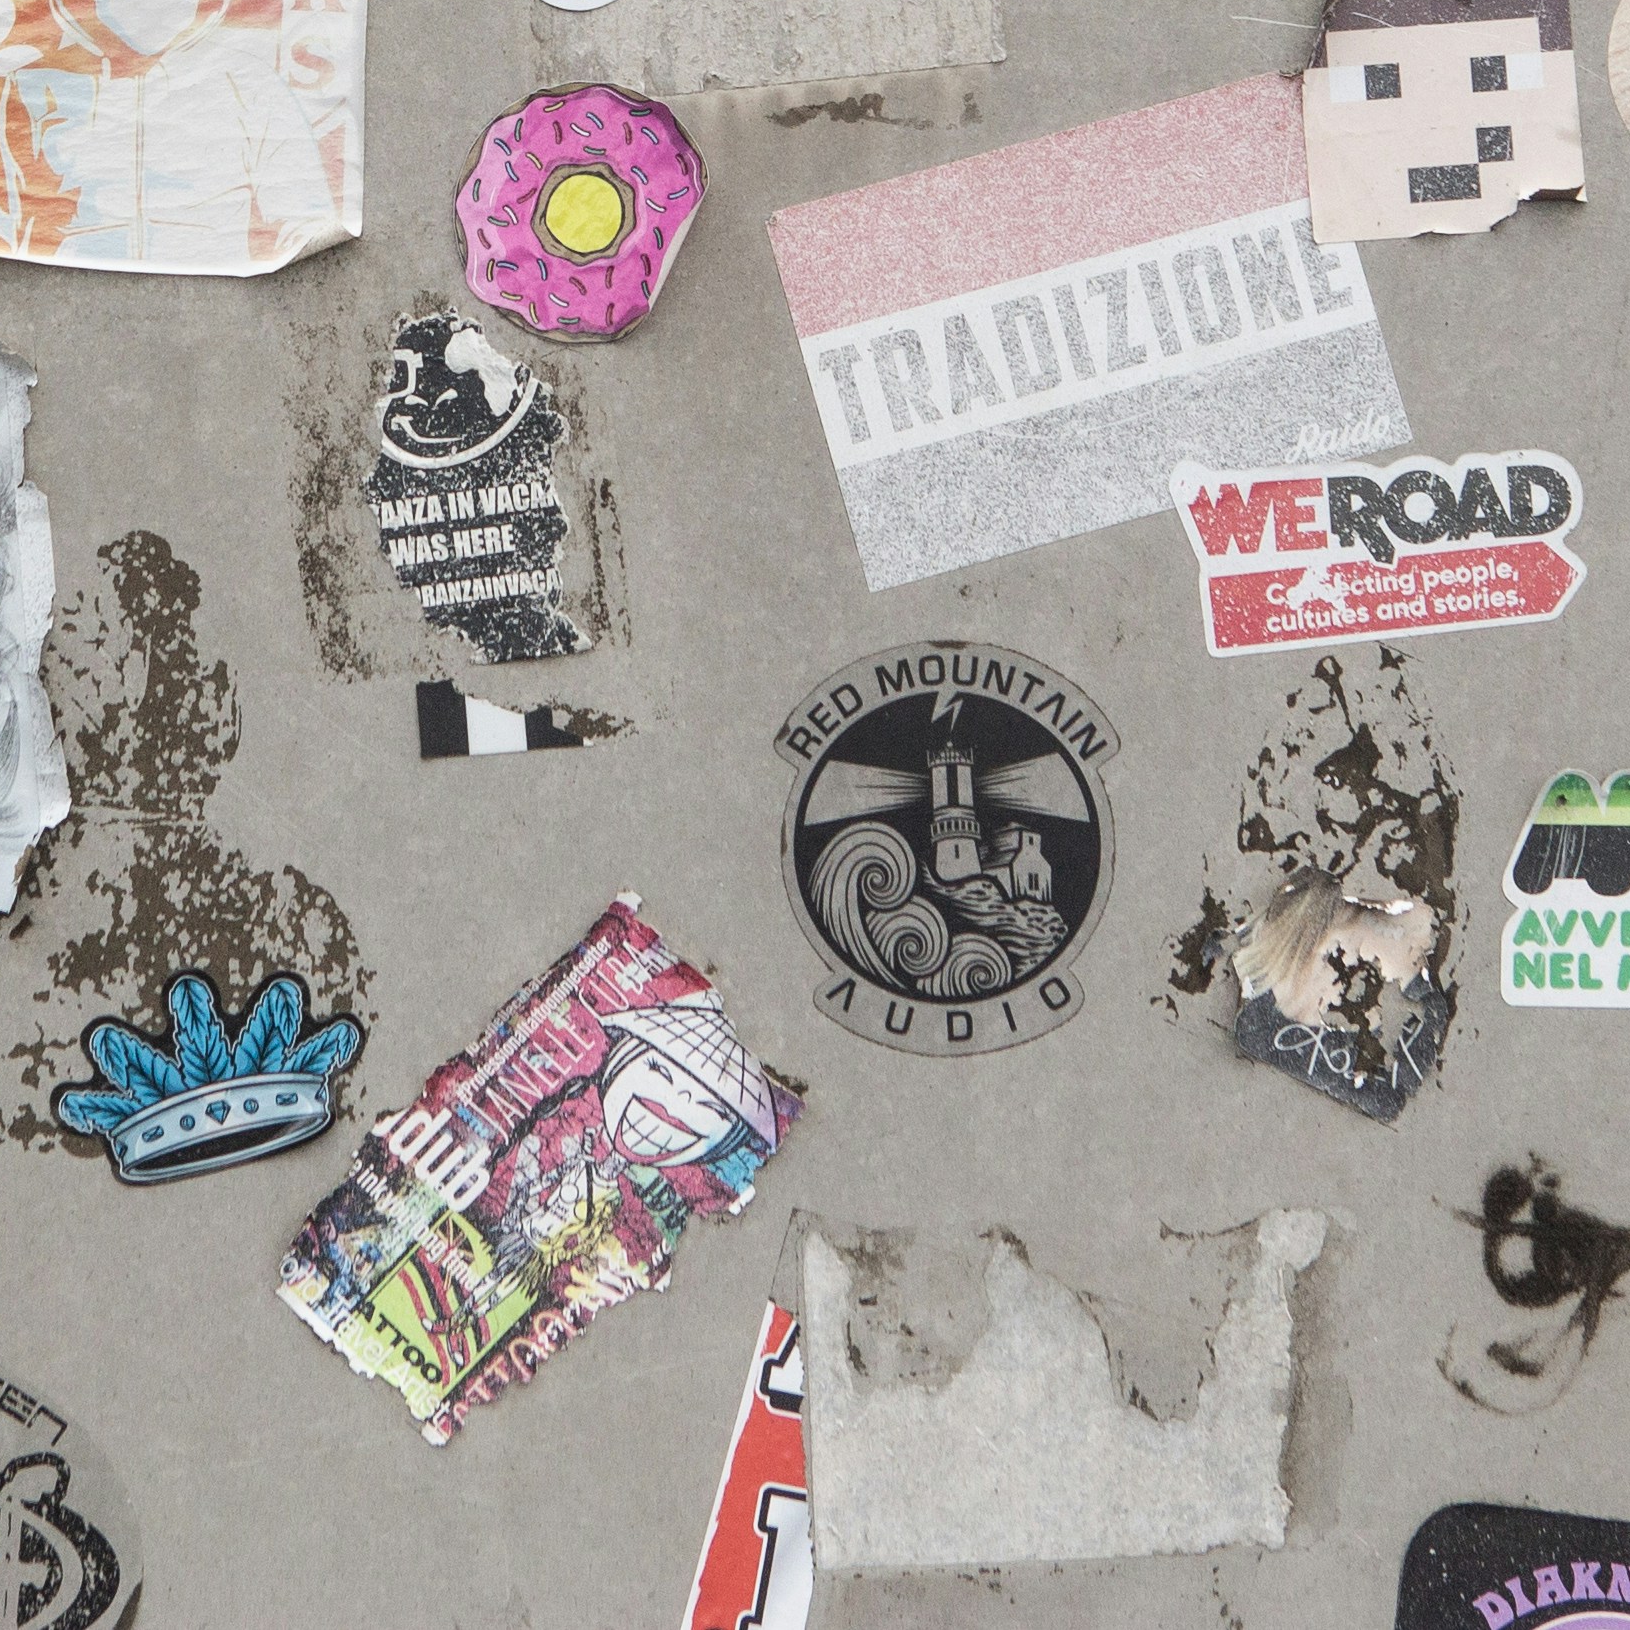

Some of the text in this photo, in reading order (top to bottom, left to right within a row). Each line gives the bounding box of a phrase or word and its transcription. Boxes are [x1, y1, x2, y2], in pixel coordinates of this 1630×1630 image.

[818, 217, 1354, 445] TRADIZIONE
[448, 489, 474, 521] IN
[1188, 465, 1572, 565] WEROAD
[389, 523, 514, 568] WAS HERE
[1421, 558, 1520, 589] people,
[1266, 588, 1526, 634] cultures and stories.
[786, 654, 1108, 761] RED MOUNTAIN
[1513, 952, 1603, 990] NEL
[826, 977, 1072, 1042] AUDIO
